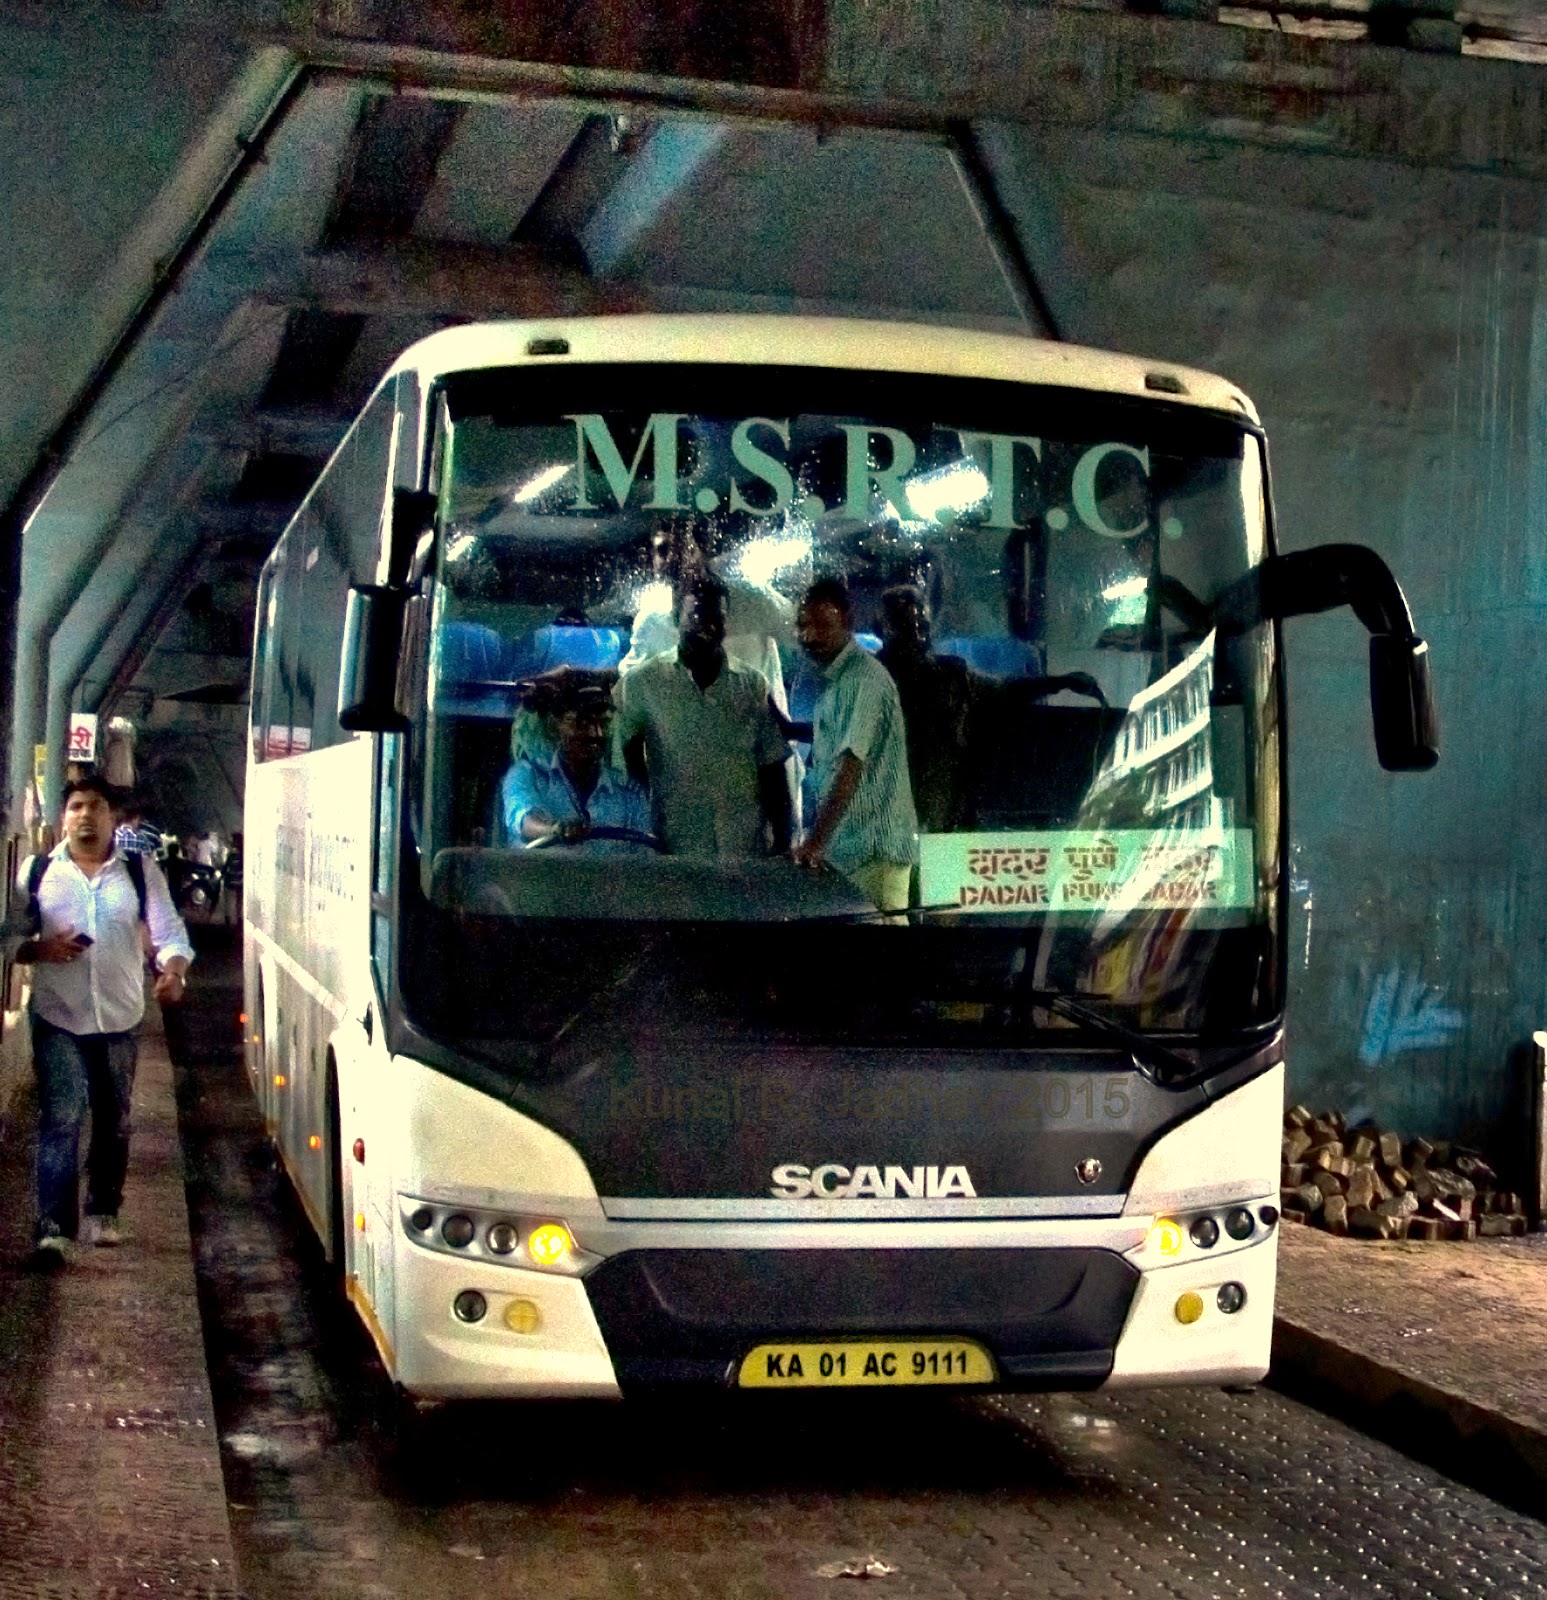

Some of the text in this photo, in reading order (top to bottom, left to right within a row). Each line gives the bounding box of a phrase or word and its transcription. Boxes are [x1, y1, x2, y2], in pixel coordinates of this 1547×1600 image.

[561, 411, 1184, 541] M.S.R.T.C.
[967, 847, 1050, 882] दादर
[1062, 838, 1119, 881] पुणे
[959, 883, 1050, 906] DADAR
[770, 1164, 978, 1199] SCANIA
[766, 1351, 967, 1378] KA 01 AC 9111
